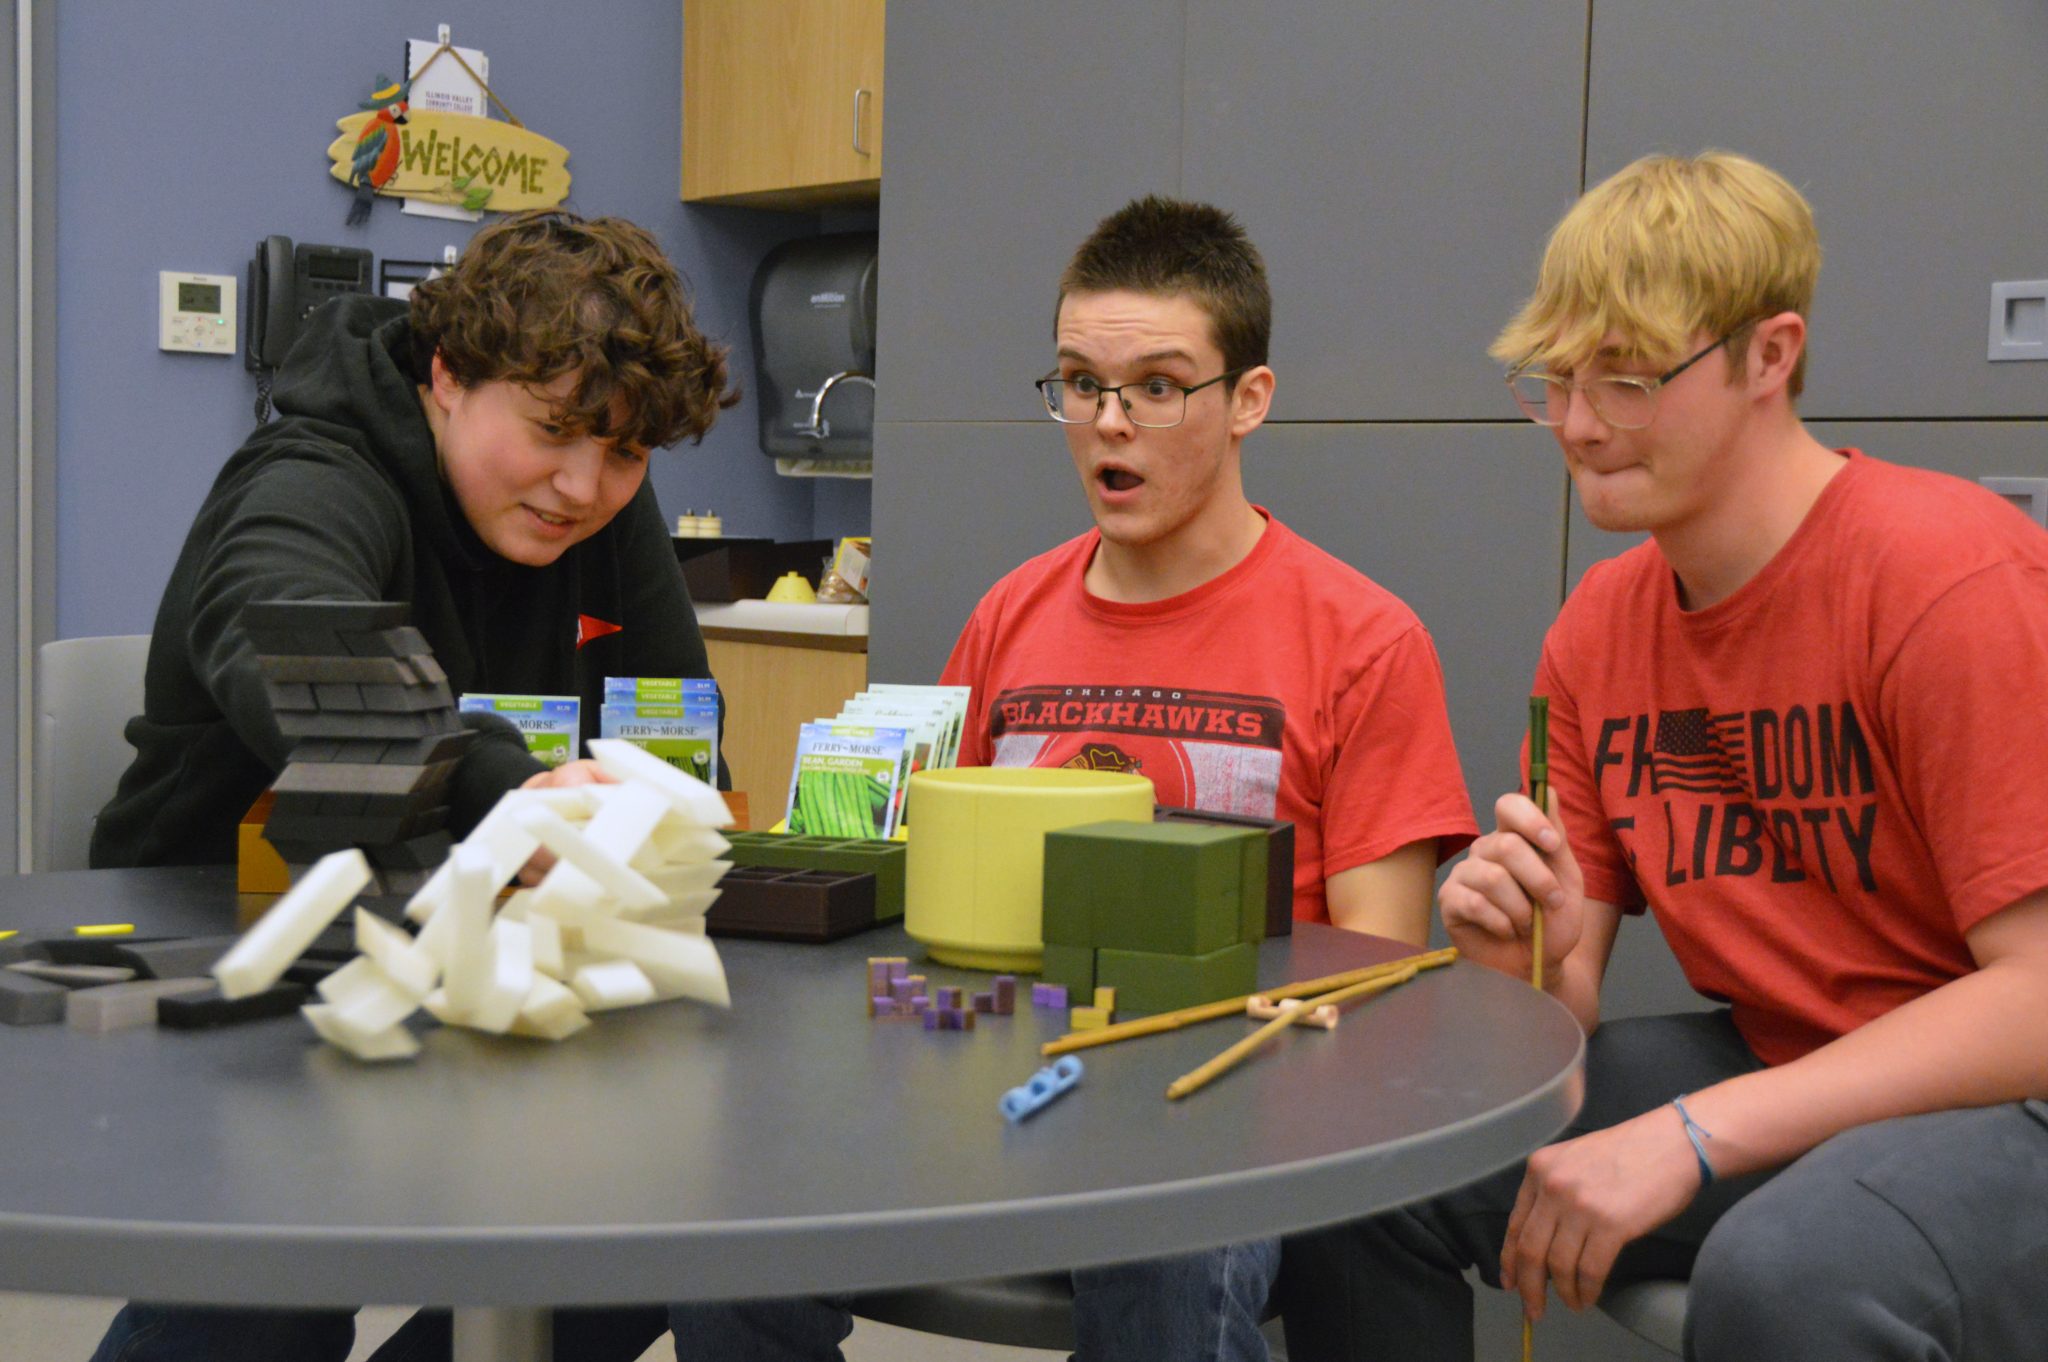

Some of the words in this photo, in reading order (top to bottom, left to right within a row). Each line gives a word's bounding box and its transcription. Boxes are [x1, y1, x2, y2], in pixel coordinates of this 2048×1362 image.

[425, 90, 450, 100] ILLINOIS
[451, 95, 473, 103] VALLEY
[401, 128, 549, 194] WELCOME
[1065, 687, 1182, 699] CHICAGO
[500, 701, 537, 709] VEGETABLE
[641, 708, 679, 716] VEGETABLE
[1001, 701, 1264, 738] BLACKHAWKS
[827, 757, 864, 768] GARDEN
